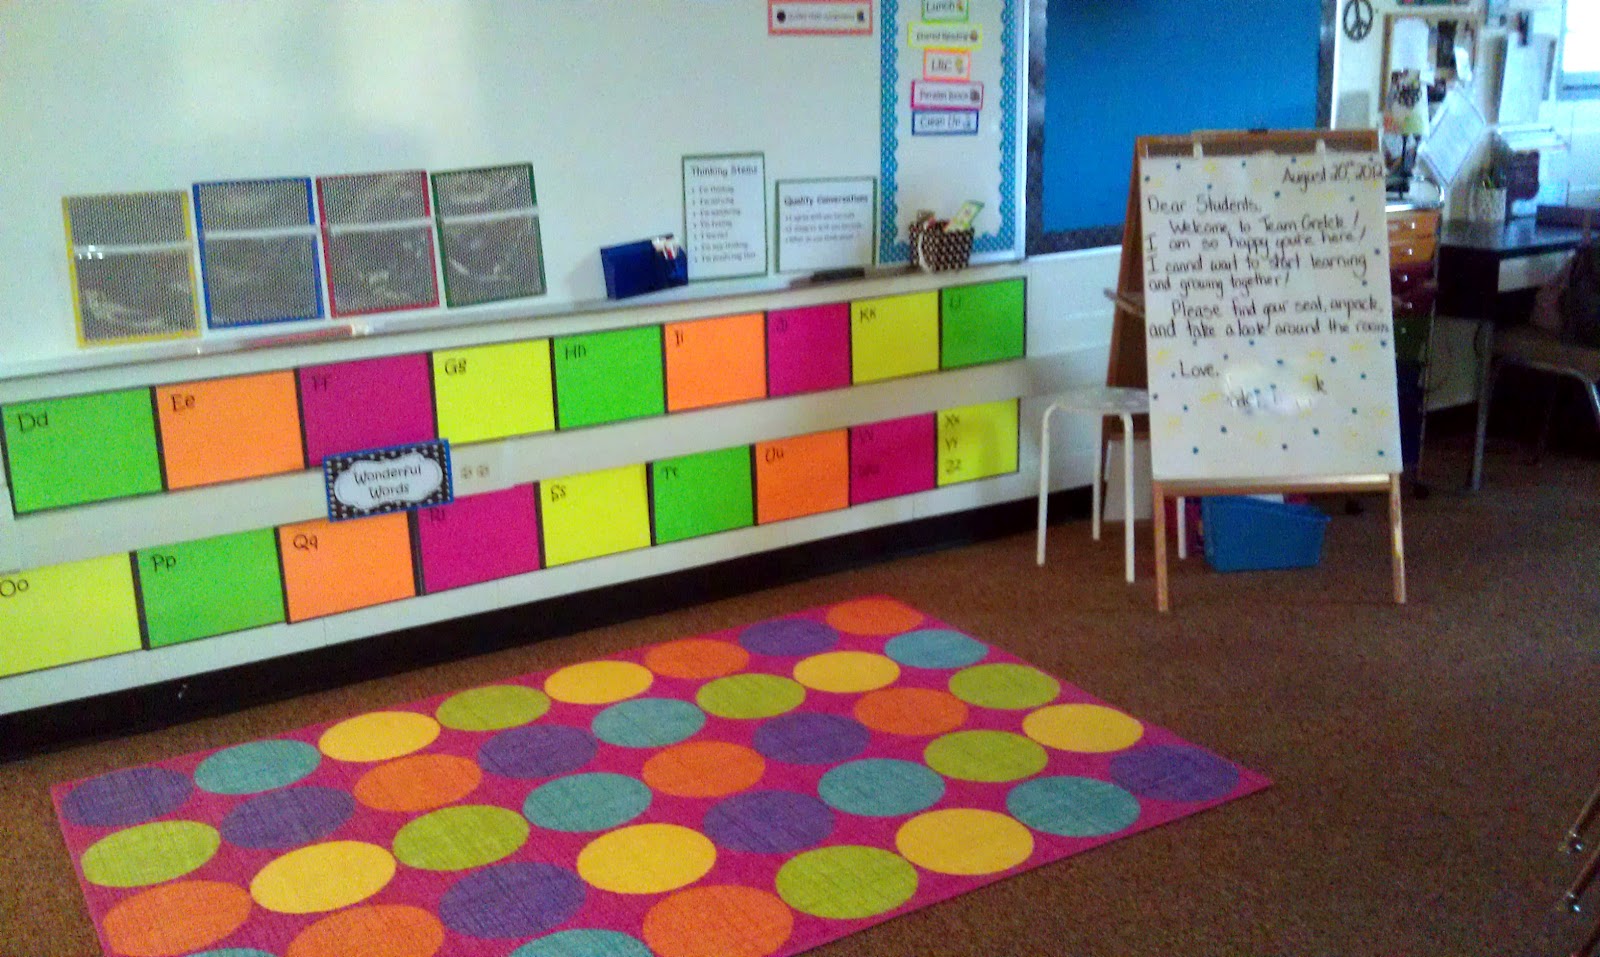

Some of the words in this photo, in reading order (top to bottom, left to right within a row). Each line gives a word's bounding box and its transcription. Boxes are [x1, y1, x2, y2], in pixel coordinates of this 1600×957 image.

[692, 167, 728, 177] Thinking
[1282, 165, 1326, 192] August
[784, 195, 813, 206] Quality
[1147, 195, 1187, 214] Dear
[1169, 218, 1227, 235] Welcome
[1239, 218, 1251, 233] to
[1259, 215, 1297, 232] Team
[1147, 233, 1158, 251] I
[1169, 239, 1191, 250] am
[1201, 238, 1219, 250] so
[1228, 232, 1271, 258] happy
[1147, 257, 1158, 275] I
[1165, 253, 1203, 273] cannot
[1210, 254, 1238, 271] wait
[1247, 255, 1260, 271] to
[1269, 254, 1300, 270] start
[1310, 253, 1368, 279] learning
[1149, 275, 1171, 291] and
[1180, 280, 1224, 298] growing
[1230, 271, 1289, 296] together!
[1171, 298, 1221, 319] Please
[1232, 299, 1258, 317] find
[1262, 301, 1287, 327] your
[1149, 319, 1177, 339] and
[1188, 319, 1216, 337] take
[1225, 323, 1235, 336] a
[1237, 318, 1266, 337] look
[1275, 318, 1320, 336] around
[1328, 318, 1350, 334] the
[18, 411, 48, 432] Dd
[171, 393, 196, 412] Ee
[353, 464, 421, 486] Wonderful
[369, 482, 410, 500] Words
[0, 578, 29, 597] Oo
[151, 553, 177, 574] Pp
[293, 533, 318, 551] Qq
